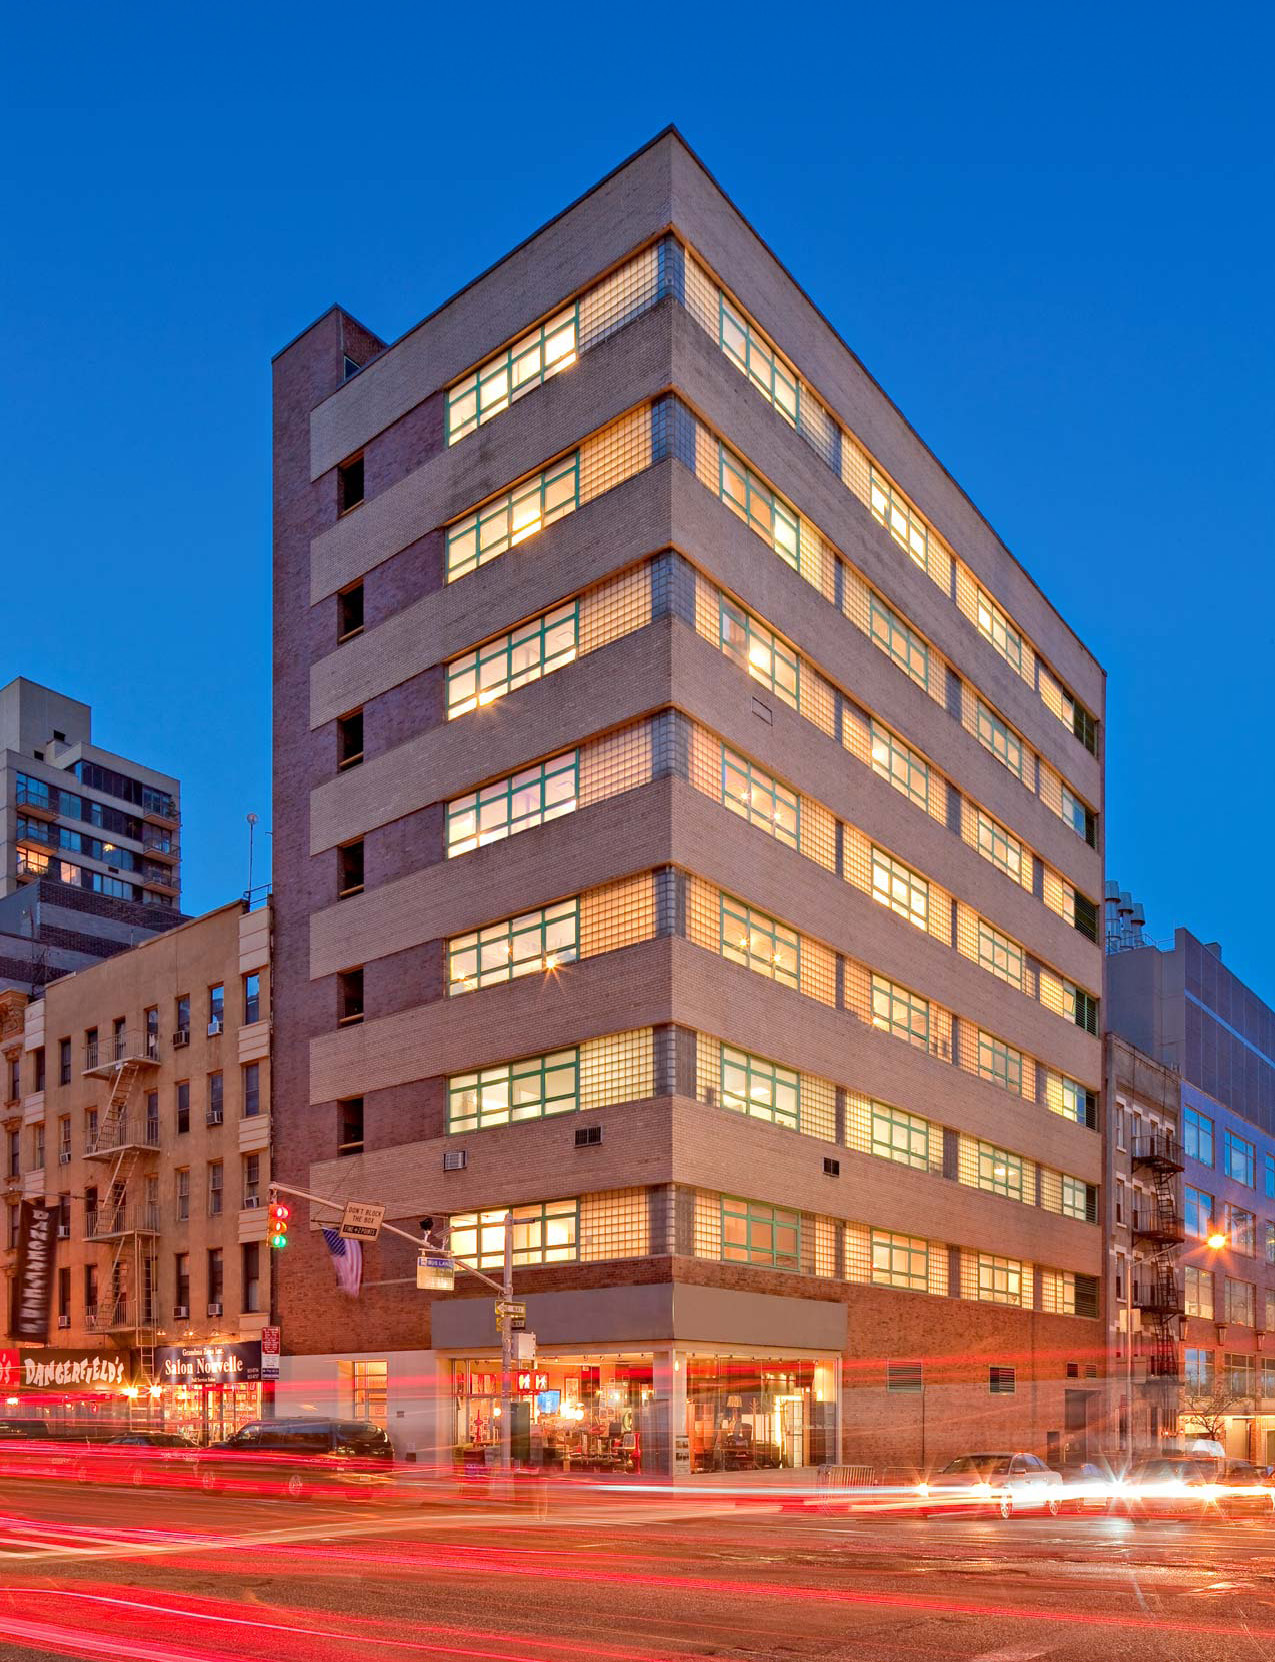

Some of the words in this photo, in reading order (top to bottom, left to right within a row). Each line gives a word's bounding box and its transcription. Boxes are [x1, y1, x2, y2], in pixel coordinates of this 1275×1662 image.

[352, 1215, 362, 1223] THE
[364, 1216, 374, 1224] BOX
[365, 1209, 381, 1217] BLOCK
[24, 1356, 124, 1387] DANGERFIELD'S
[165, 1358, 193, 1376] Salon
[197, 1355, 243, 1374] Nouvelle
